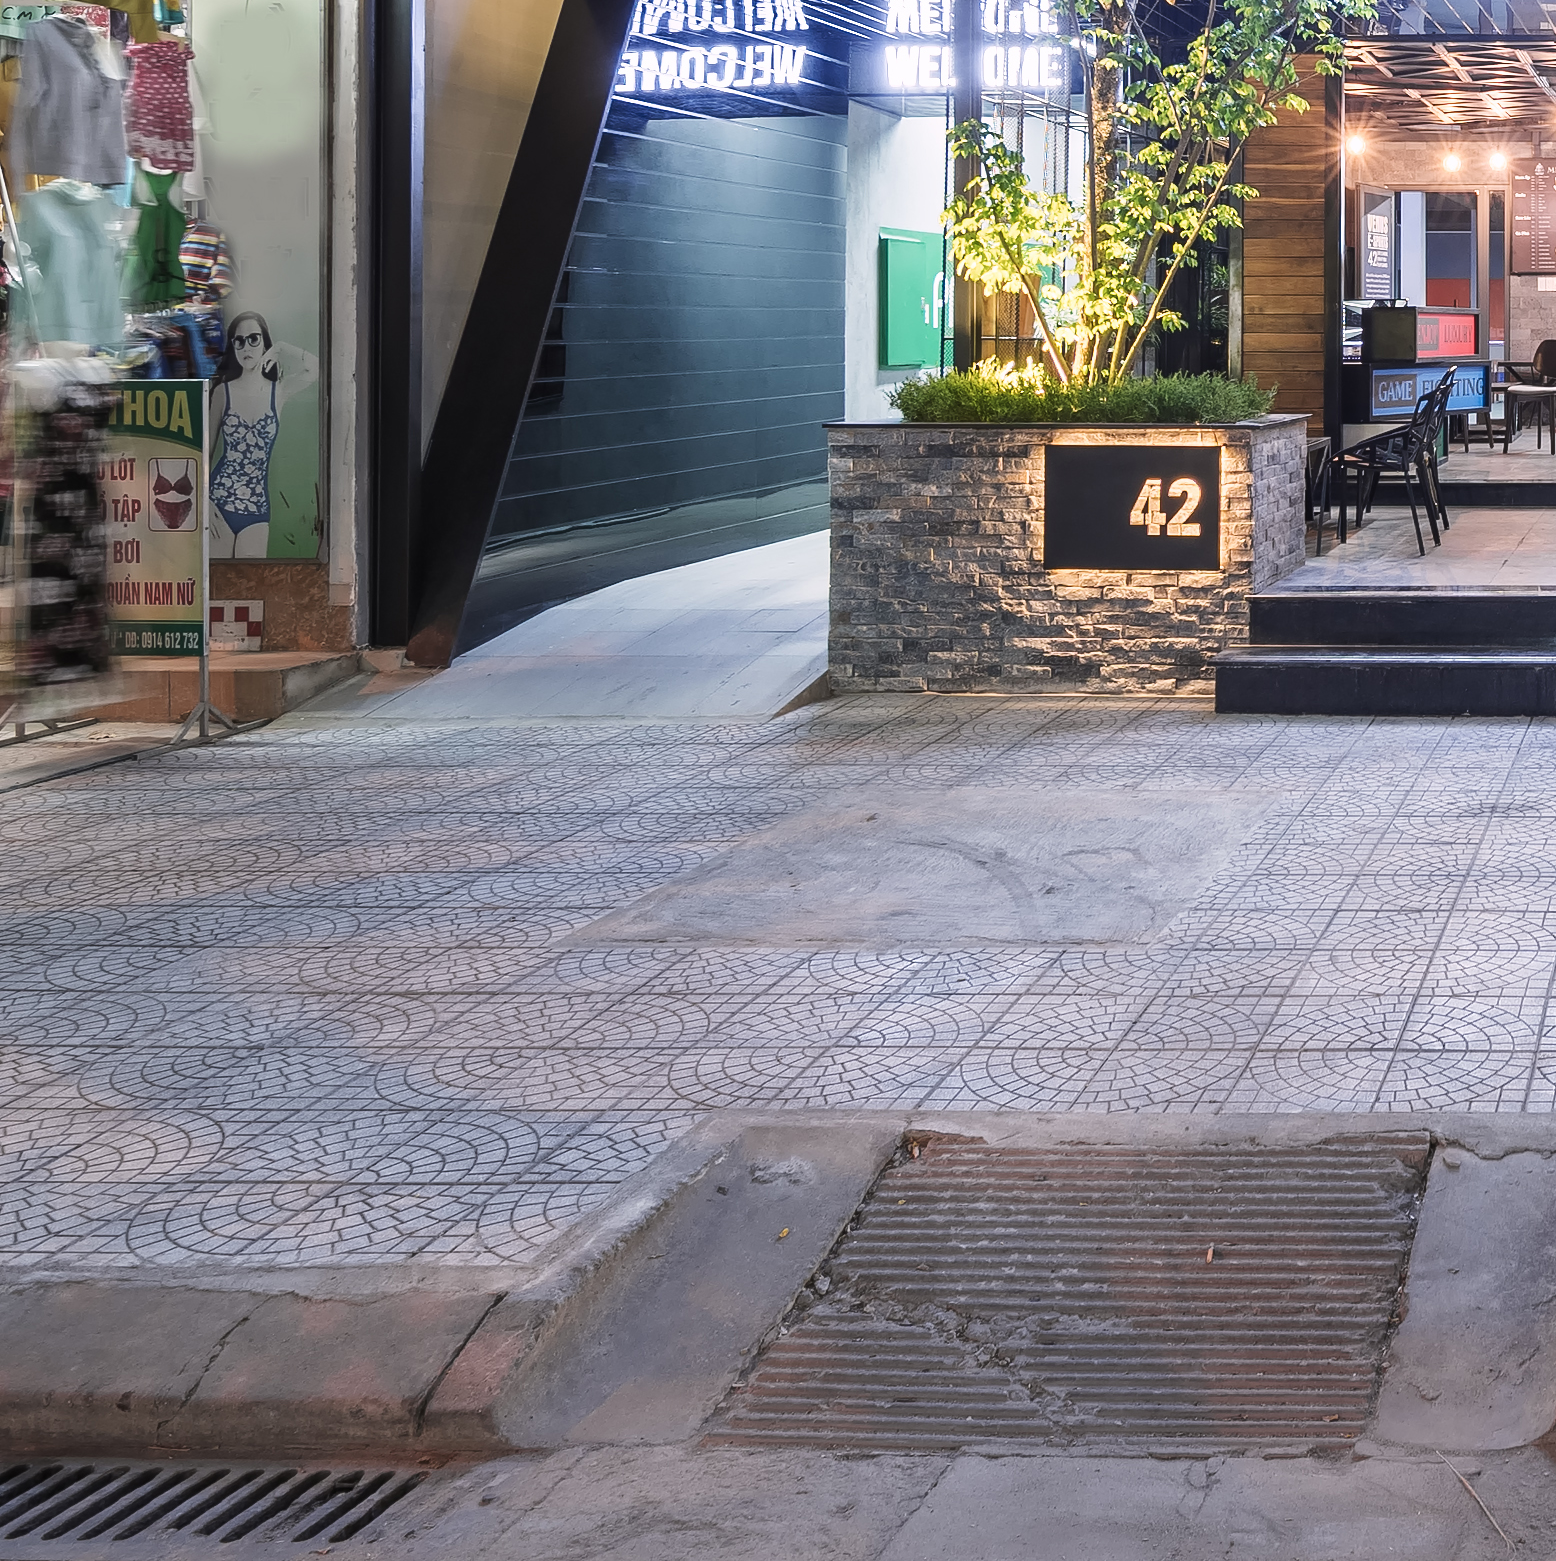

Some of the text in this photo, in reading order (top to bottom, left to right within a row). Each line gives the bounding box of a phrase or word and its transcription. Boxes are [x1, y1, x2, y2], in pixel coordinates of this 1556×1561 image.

[884, 45, 1064, 88] WELOME
[1378, 380, 1413, 402] GAME
[112, 494, 142, 527] TẬP
[1130, 478, 1202, 537] 42
[113, 538, 141, 563] BƠI
[145, 582, 173, 606] NAM
[177, 577, 196, 606] NỮ
[142, 632, 162, 649] 0914
[165, 632, 181, 649] 612
[183, 632, 199, 649] 732
